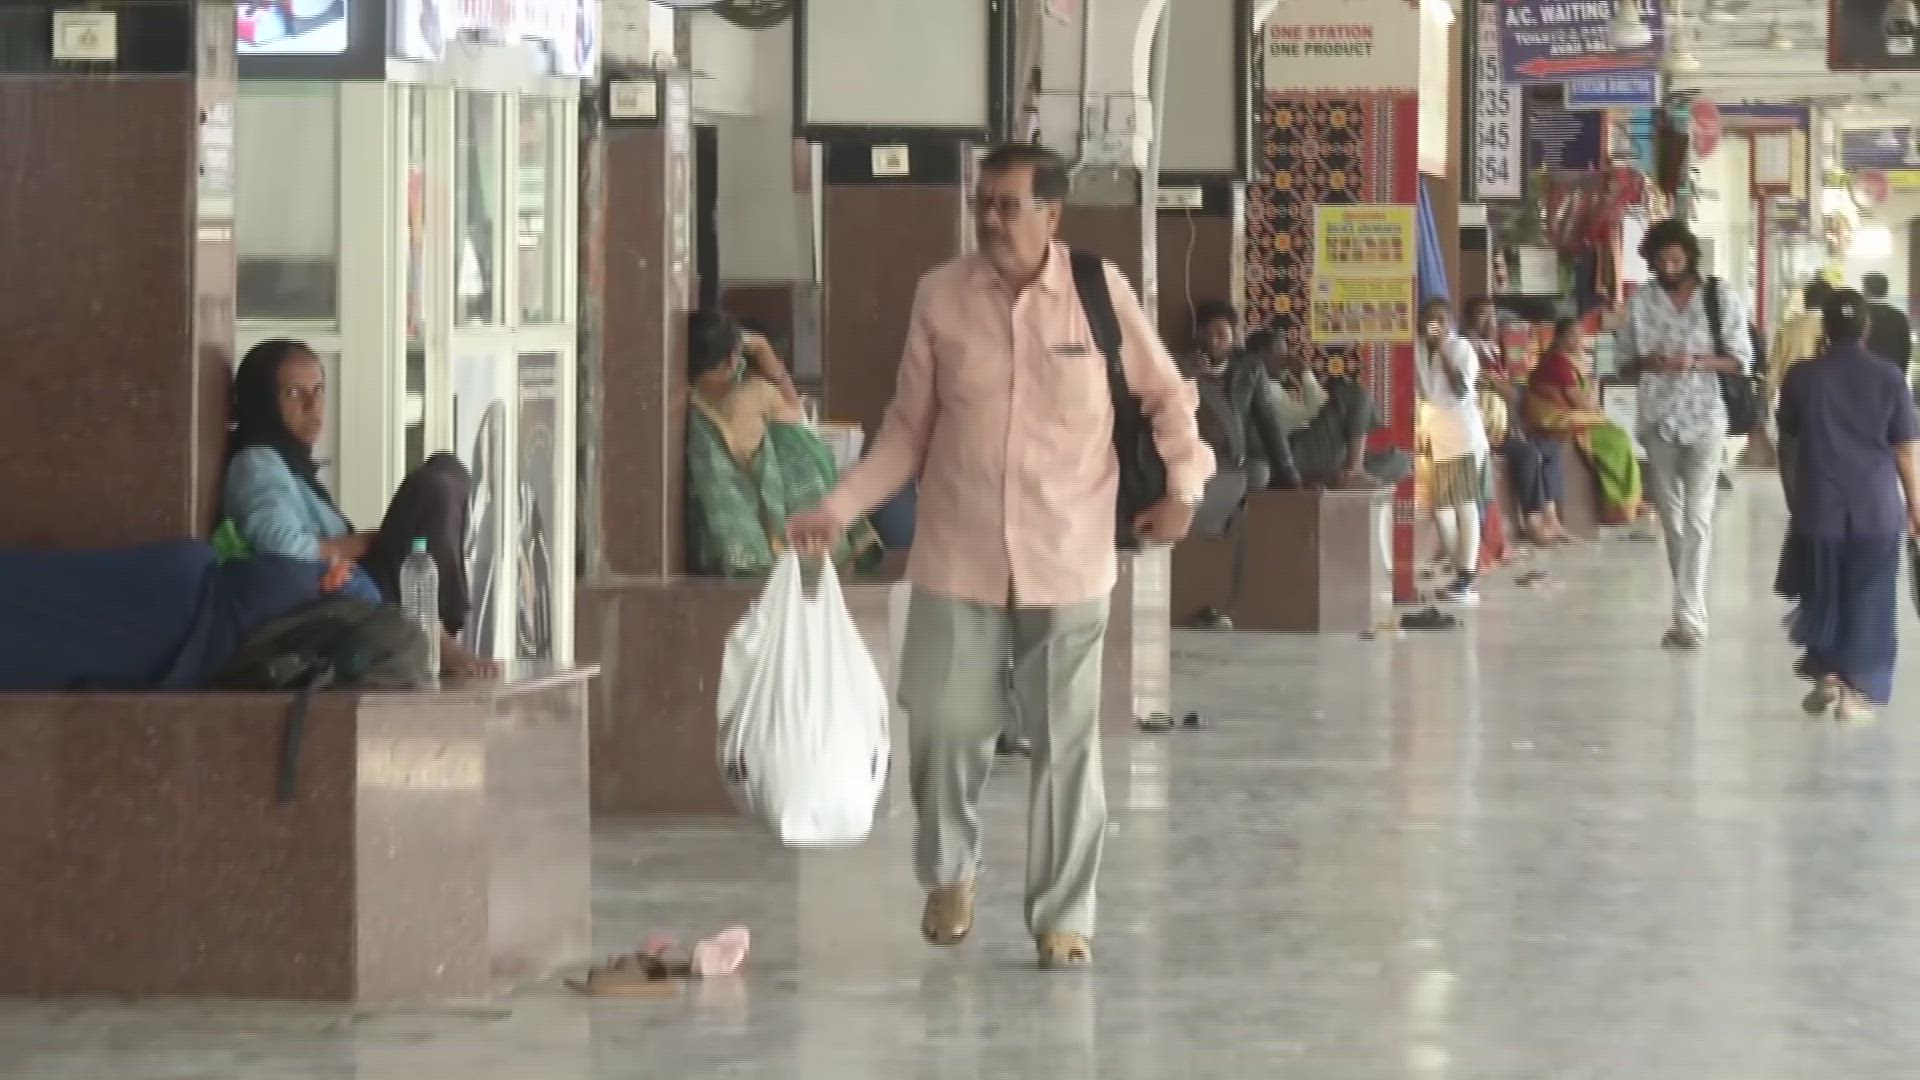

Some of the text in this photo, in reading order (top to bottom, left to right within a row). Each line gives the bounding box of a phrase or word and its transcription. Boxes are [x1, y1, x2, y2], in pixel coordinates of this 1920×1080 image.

[1539, 1, 1611, 23] WAITING
[1269, 23, 1373, 40] ONE STATION
[1269, 42, 1373, 57] ONE PRODUCT
